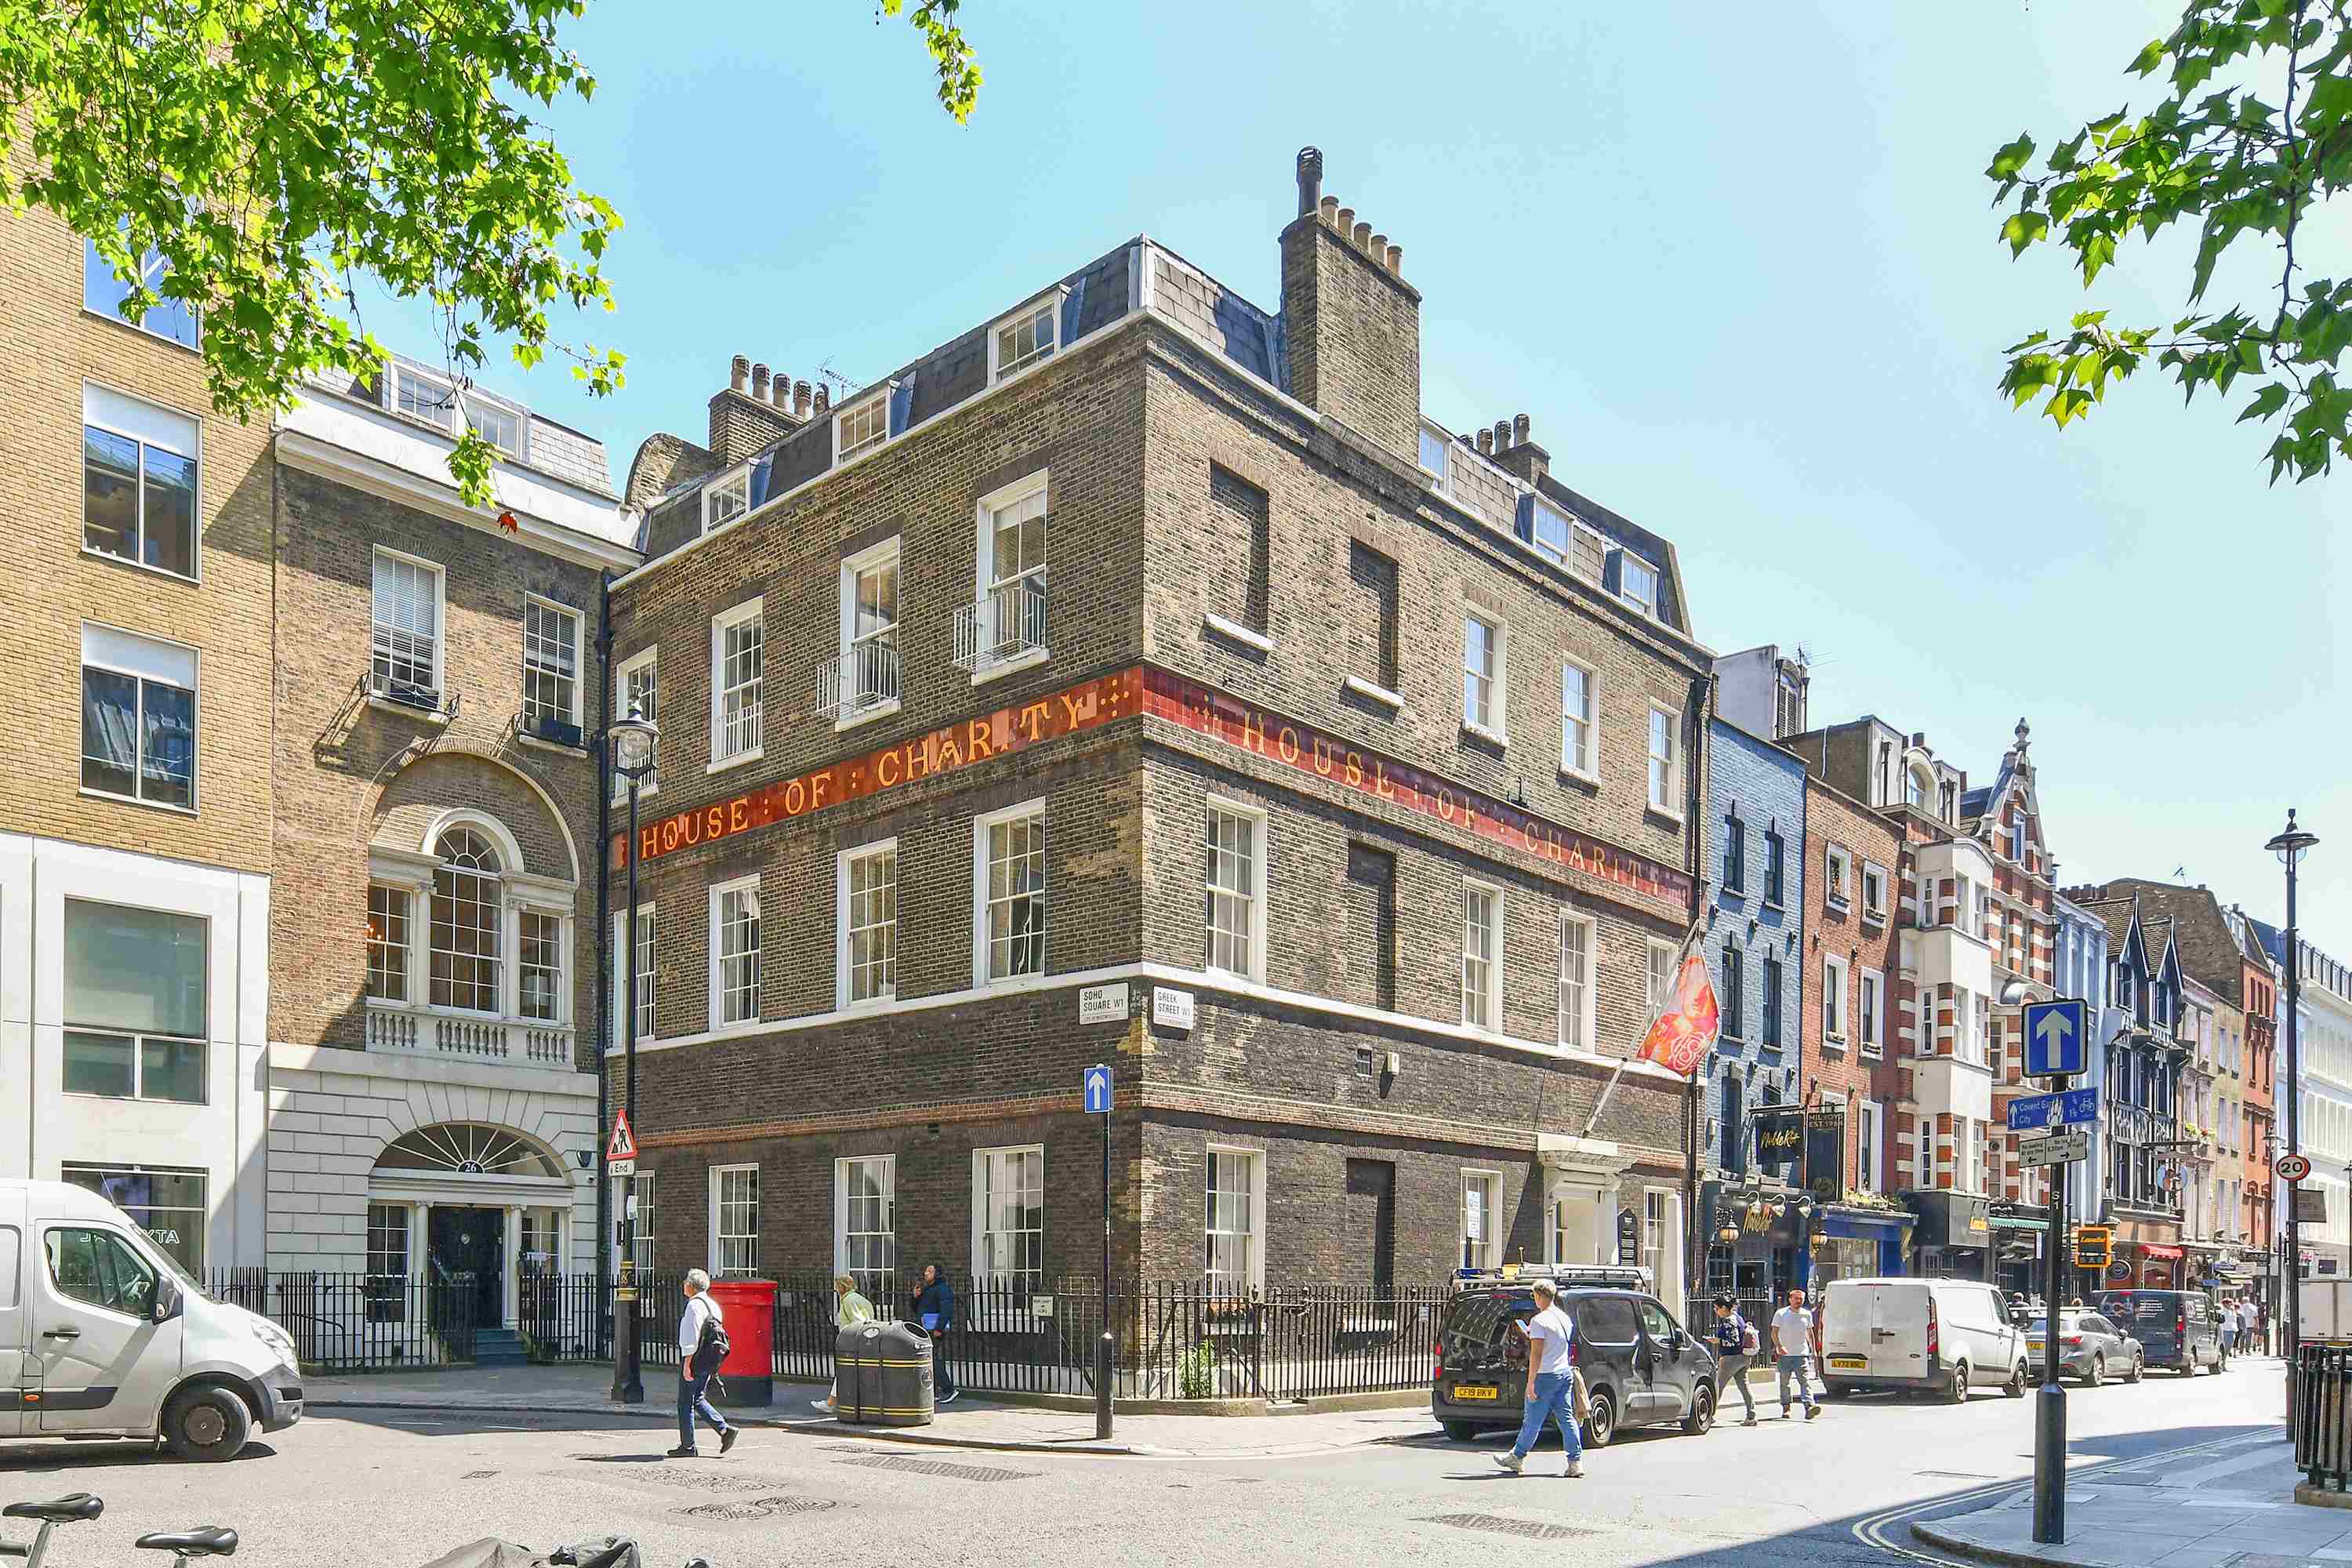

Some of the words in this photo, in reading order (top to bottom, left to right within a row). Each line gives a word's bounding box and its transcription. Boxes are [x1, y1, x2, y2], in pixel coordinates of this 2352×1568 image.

[641, 797, 749, 859] HOUSE
[784, 771, 832, 815] OF
[877, 693, 1083, 787] CHARTY
[1083, 989, 1103, 1001] SOHO
[1157, 991, 1178, 1004] GREEK
[1083, 1000, 1111, 1012] SQUARE
[1113, 998, 1123, 1009] W1
[1157, 1003, 1180, 1016] STREET
[1181, 1007, 1191, 1017] W1
[2019, 1102, 2041, 1112] Covent
[2019, 1116, 2031, 1125] City
[465, 1163, 477, 1172] 26
[615, 1163, 628, 1173] End
[2281, 1162, 2303, 1173] 20
